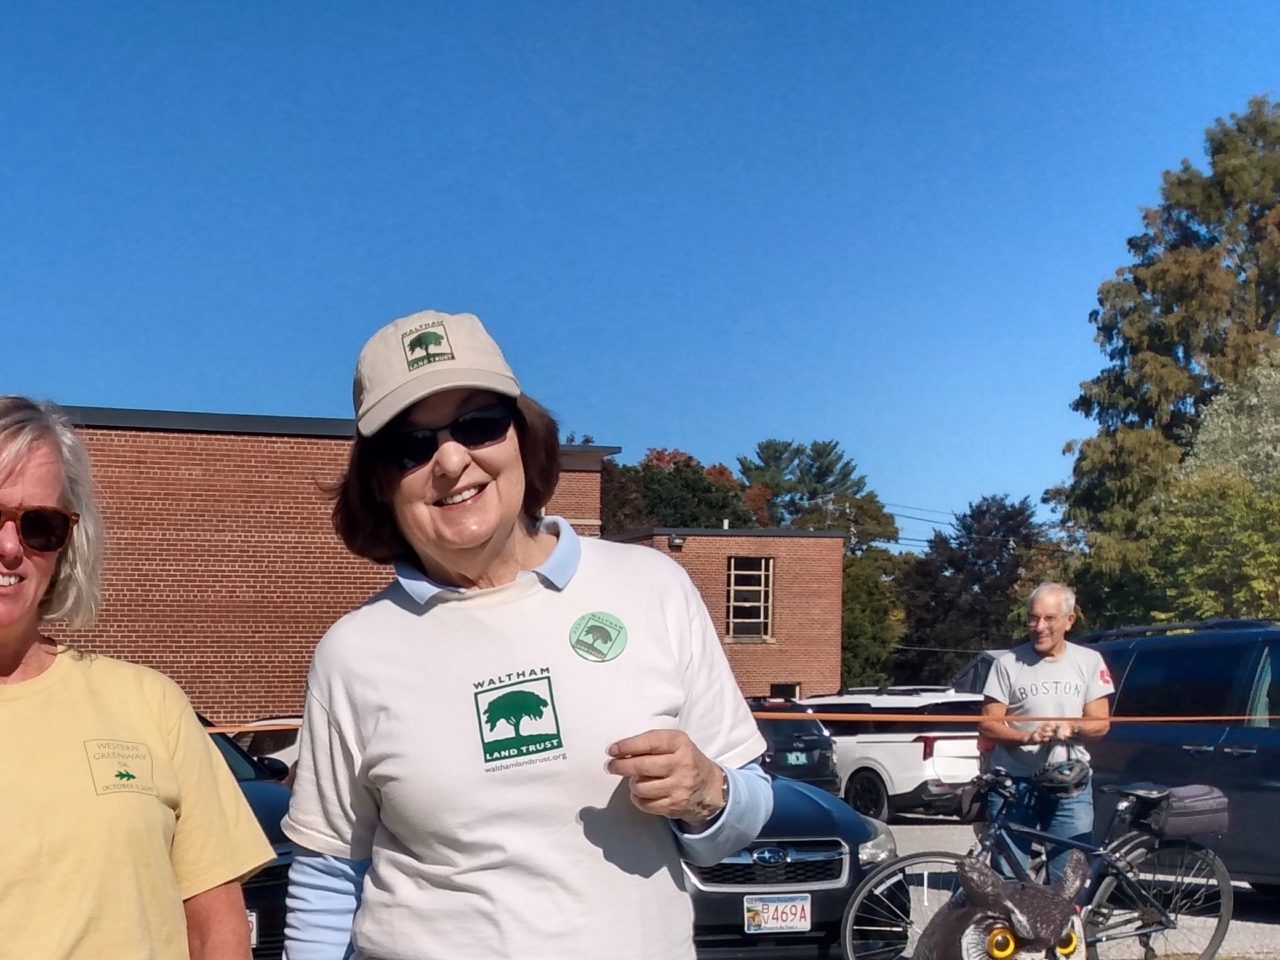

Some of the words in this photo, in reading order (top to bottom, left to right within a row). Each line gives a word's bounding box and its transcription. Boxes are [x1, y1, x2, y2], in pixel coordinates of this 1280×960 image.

[401, 320, 443, 338] WALTHAM
[431, 354, 452, 362] TRUST
[473, 667, 550, 689] WALTHAM
[1018, 681, 1081, 701] BOSTON
[96, 743, 139, 751] WESTERN
[486, 748, 517, 760] LAND
[520, 739, 559, 753] TRUST
[484, 752, 568, 774] walthamlandtrust.org
[772, 904, 807, 922] 469A
